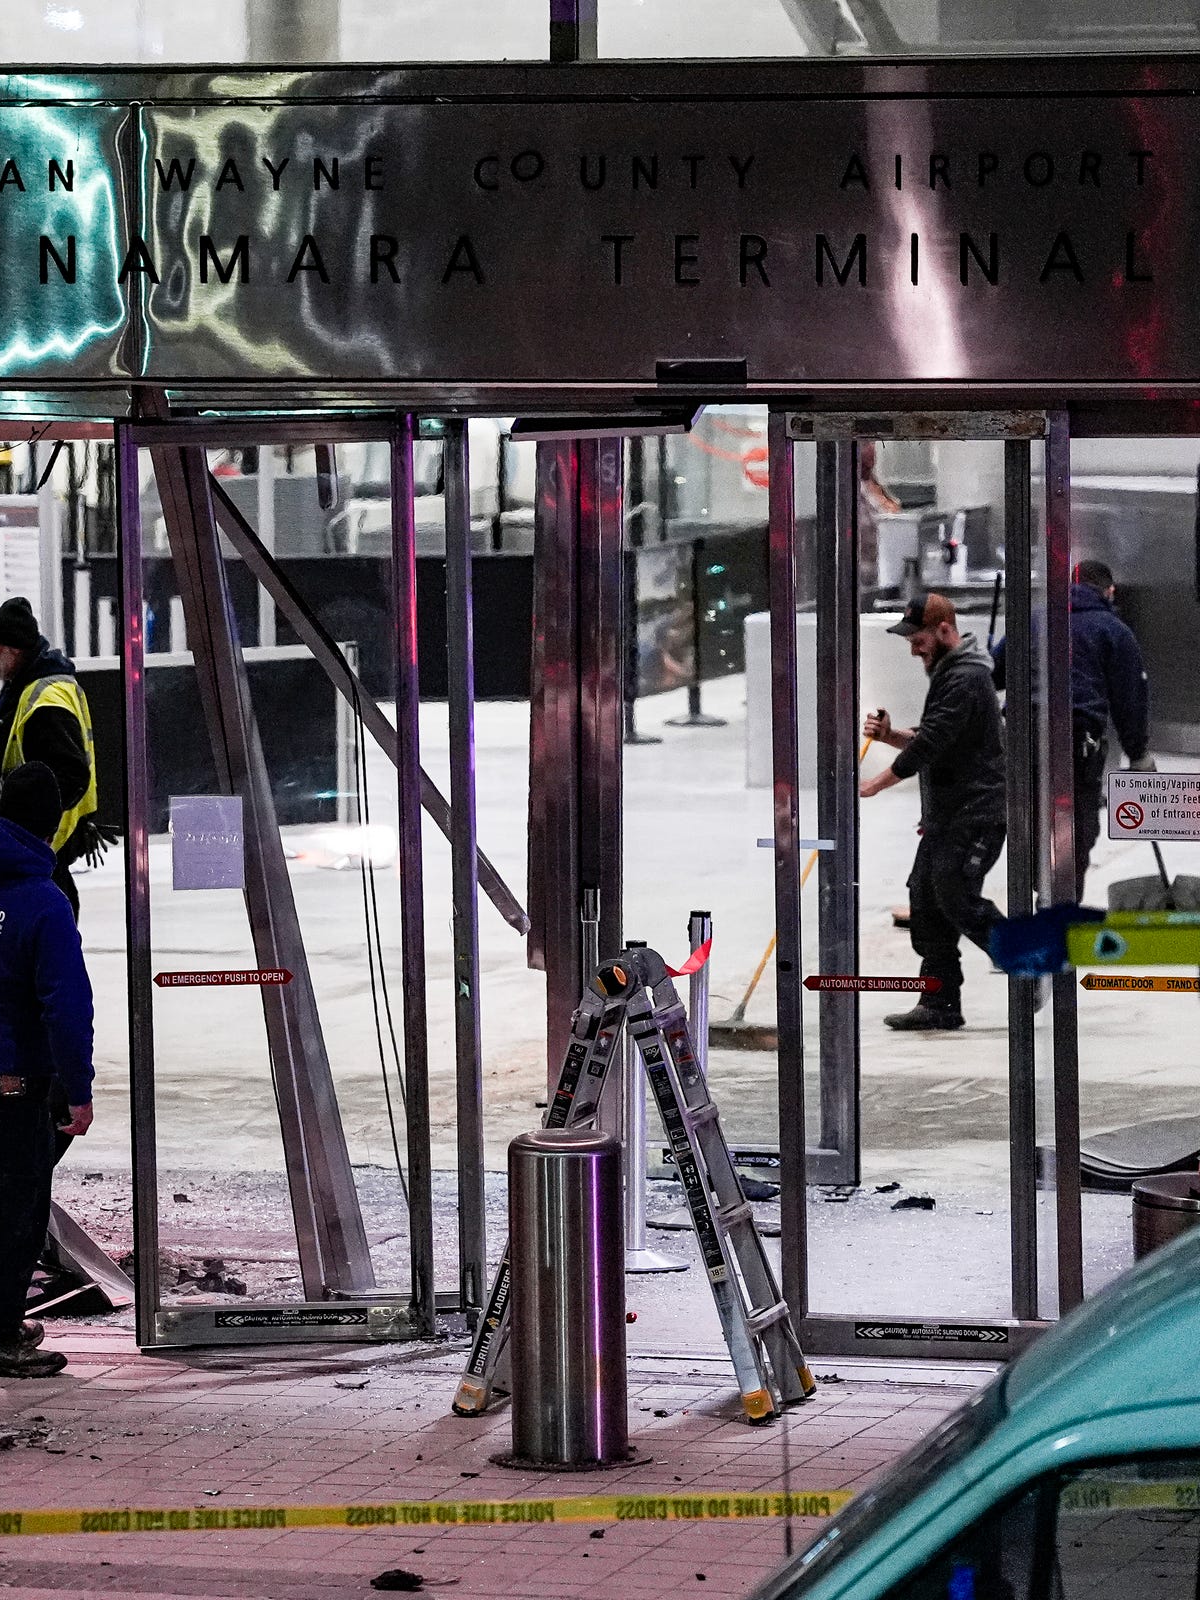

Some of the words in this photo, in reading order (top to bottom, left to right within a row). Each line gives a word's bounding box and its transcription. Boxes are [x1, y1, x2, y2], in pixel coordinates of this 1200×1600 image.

[154, 156, 384, 192] WAYNE
[472, 149, 755, 191] COUNTY
[839, 149, 1154, 192] AIRPORT
[599, 231, 1155, 287] TERMINAL
[1115, 779, 1127, 789] No
[1129, 779, 1200, 791] Smoking/Vaping
[1139, 794, 1168, 804] Within
[1170, 794, 1180, 804] 25
[1151, 808, 1160, 819] of
[1163, 809, 1200, 819] Entrance
[161, 975, 171, 985] IN
[172, 974, 224, 984] EMERGENCY
[224, 973, 247, 983] PUSH
[249, 973, 260, 982] TO
[261, 972, 285, 982] OPEN
[819, 979, 866, 989] AUTOMATIC
[867, 980, 901, 989] SLIDING
[901, 980, 926, 990] DOOR
[1086, 978, 1130, 989] AUTOMATIC
[1131, 979, 1154, 989] DOOR
[1166, 979, 1192, 990] STAND
[473, 1331, 494, 1374] GORILLA
[492, 1269, 511, 1315] LADDERS
